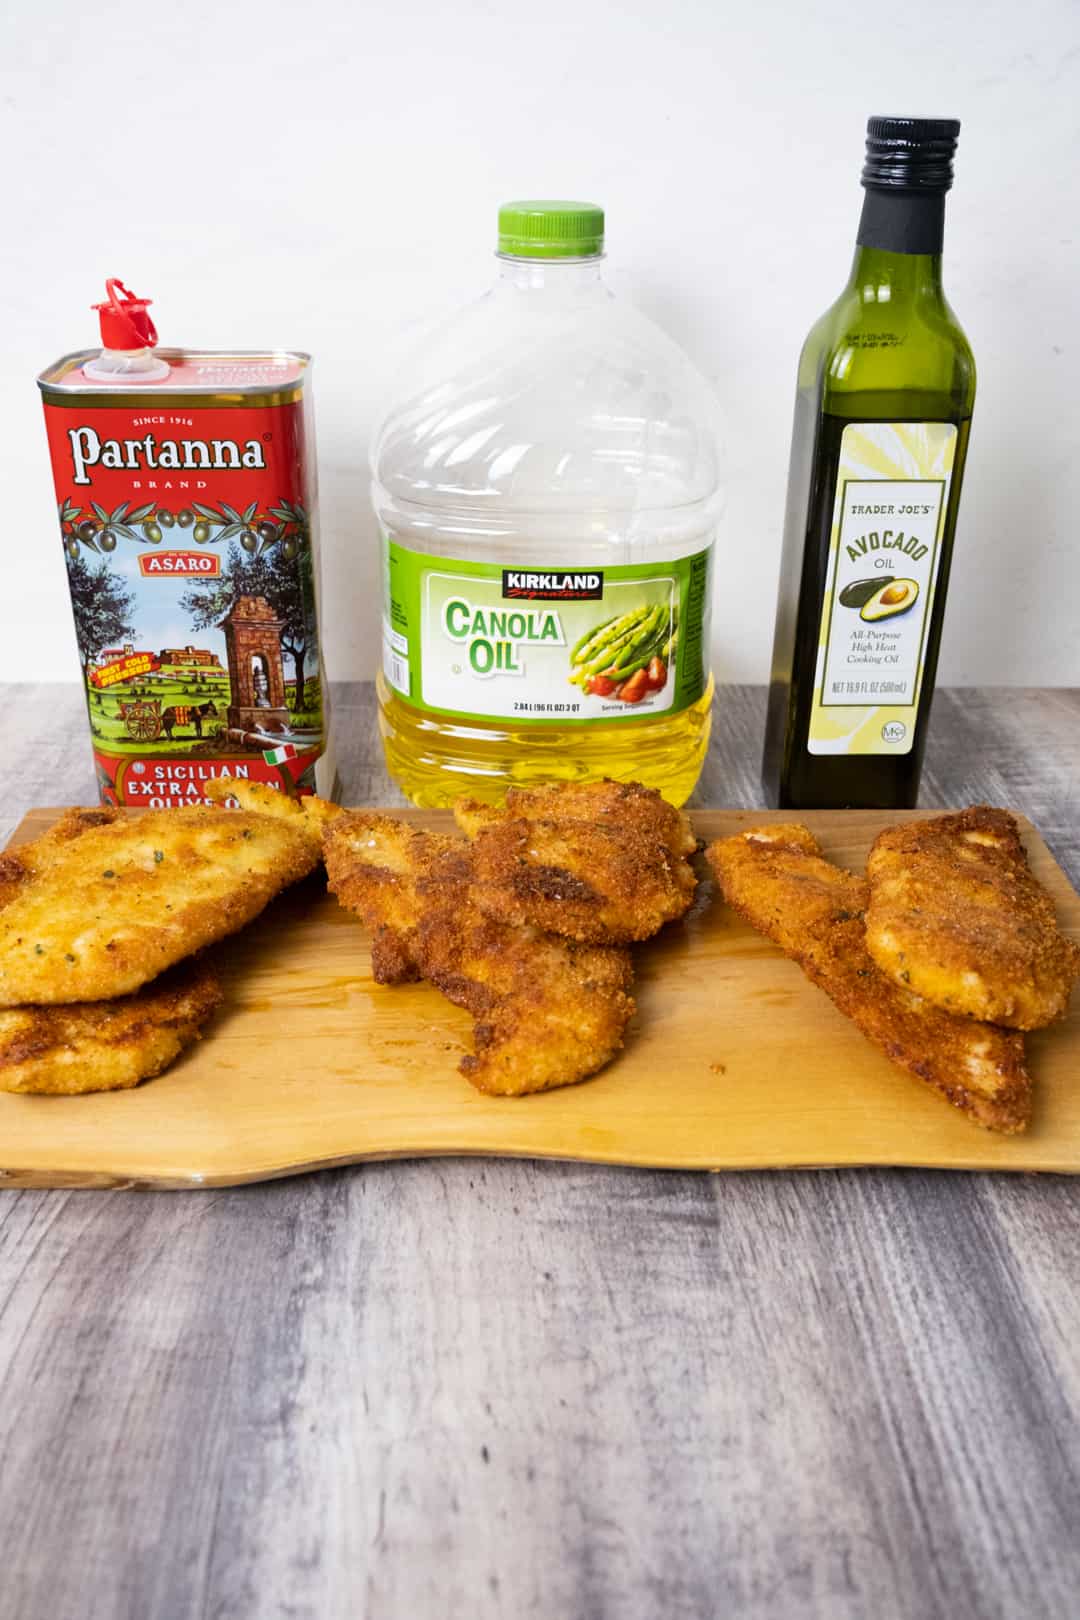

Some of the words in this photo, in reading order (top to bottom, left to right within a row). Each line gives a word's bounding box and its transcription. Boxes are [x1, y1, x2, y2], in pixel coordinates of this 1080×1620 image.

[133, 416, 166, 427] SINCE
[169, 416, 193, 427] 1916
[67, 425, 265, 485] Partanna
[133, 480, 207, 489] BRAND
[851, 505, 895, 515] TRADER
[897, 504, 931, 515] JOE'S
[846, 530, 929, 562] AVOCADO
[148, 558, 212, 571] ASARO
[873, 558, 895, 569] OIL
[507, 573, 600, 590] KIRKLAND
[446, 601, 559, 640] CANOLA
[850, 630, 902, 641] All-Purpose
[851, 642, 873, 653] High
[876, 642, 897, 652] Heat
[124, 655, 149, 668] COLD
[469, 638, 519, 673] OIL
[847, 654, 882, 665] Cooking
[884, 654, 899, 664] Oil
[154, 764, 249, 779] SICILIAN
[128, 781, 199, 795] EXTRA
